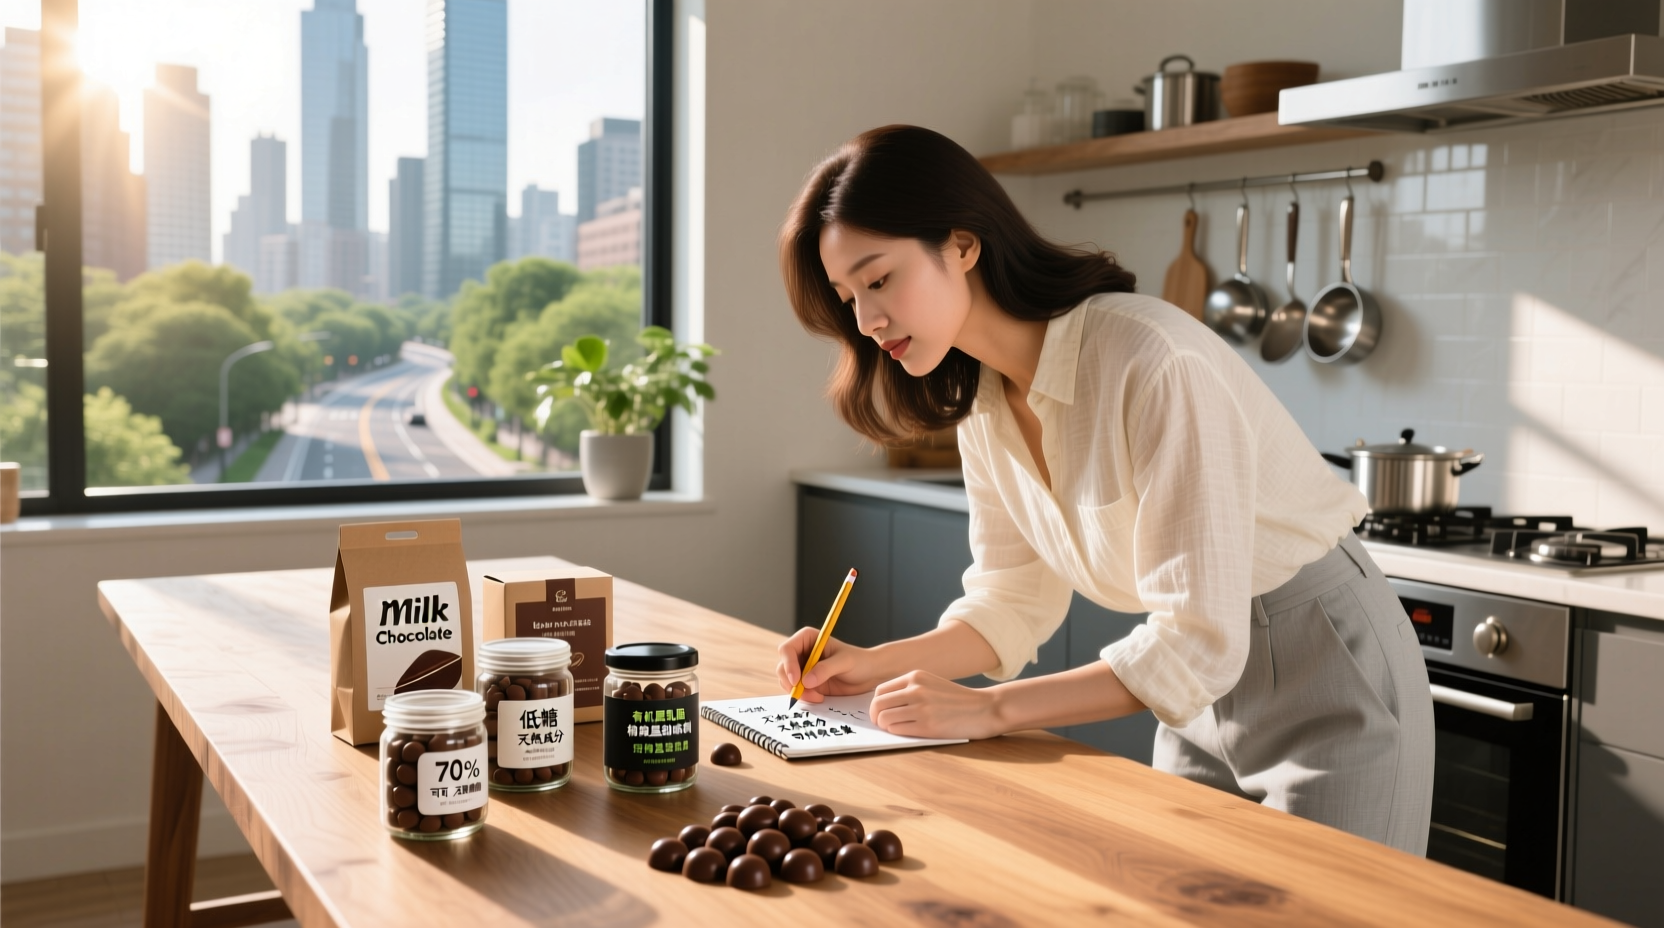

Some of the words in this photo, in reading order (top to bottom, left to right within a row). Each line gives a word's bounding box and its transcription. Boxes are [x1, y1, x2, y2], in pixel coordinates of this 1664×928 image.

[379, 594, 449, 626] Milk
[376, 626, 453, 645] Chocolate
[519, 707, 559, 730] 低糖
[435, 758, 480, 783] 70%
